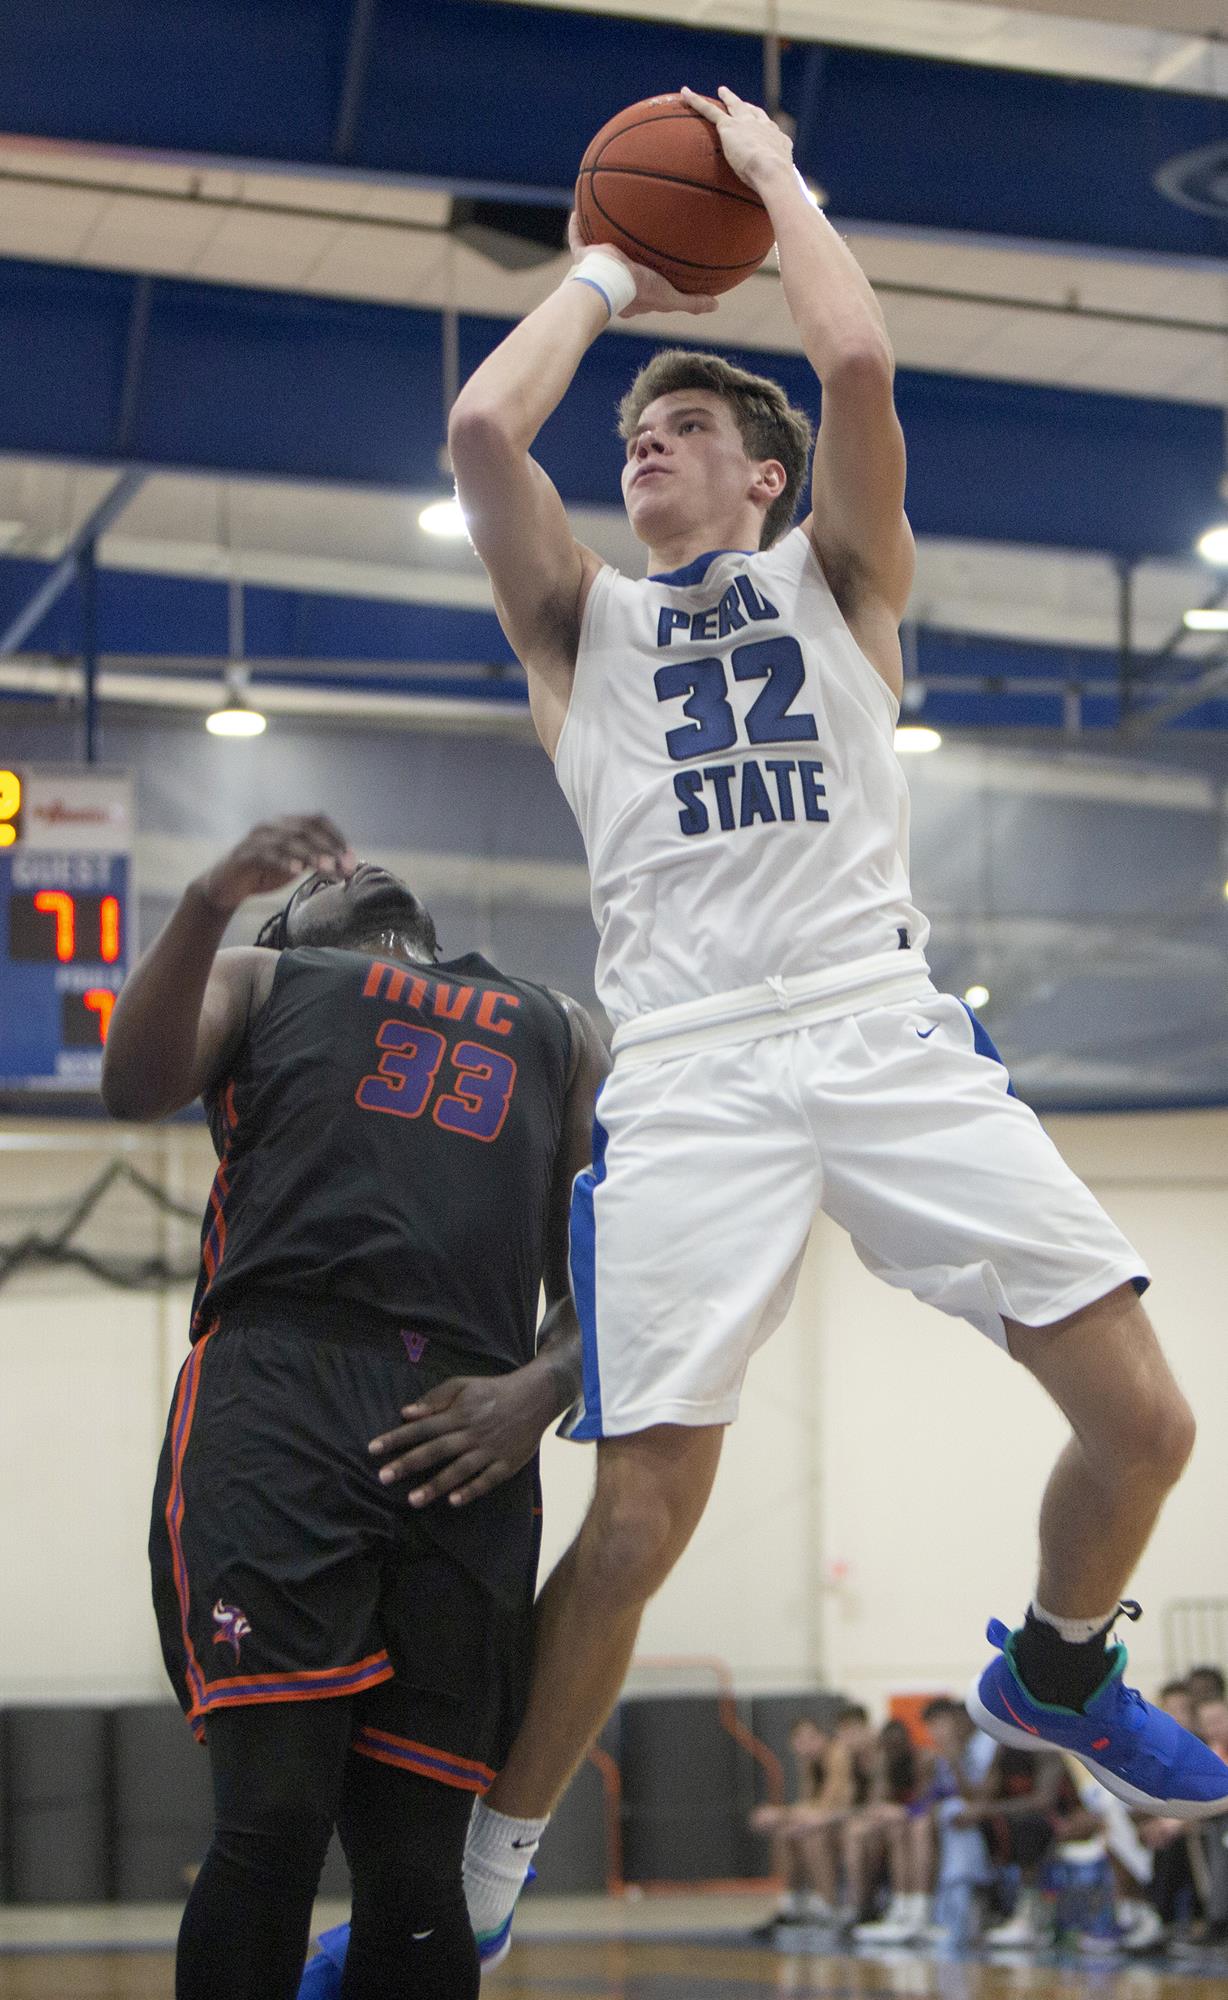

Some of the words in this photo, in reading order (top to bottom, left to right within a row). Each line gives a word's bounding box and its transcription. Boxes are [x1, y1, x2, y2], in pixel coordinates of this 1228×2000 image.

[656, 574, 780, 647] PERU
[653, 635, 819, 761] 32
[673, 760, 830, 836] STATE
[33, 889, 120, 964] 71
[362, 960, 520, 1036] MVC
[355, 1019, 517, 1143] 33
